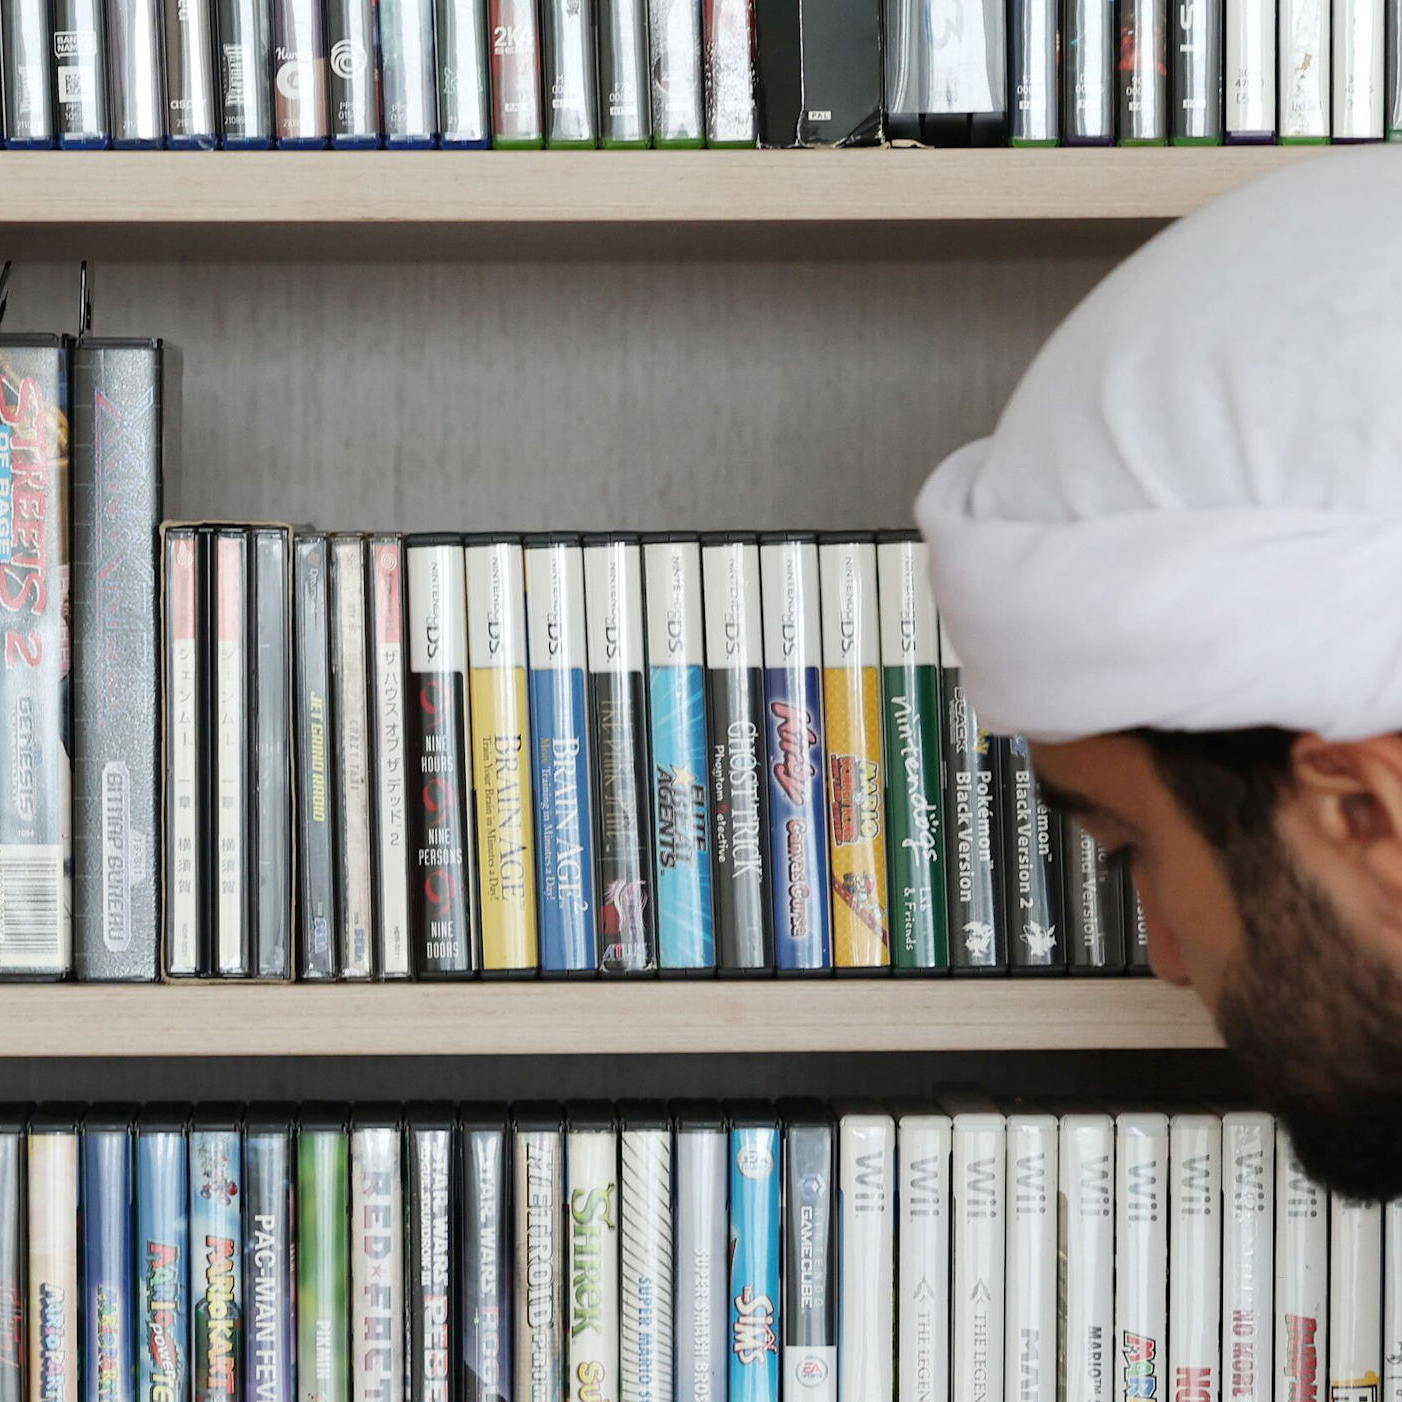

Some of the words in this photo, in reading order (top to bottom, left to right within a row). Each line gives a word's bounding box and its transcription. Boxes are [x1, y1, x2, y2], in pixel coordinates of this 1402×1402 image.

[5, 630, 41, 670] 2
[310, 691, 325, 721] JET
[311, 723, 324, 771] GRIND
[426, 736, 447, 752] NINE
[481, 737, 492, 760] Train
[727, 721, 758, 805] GHOST
[421, 756, 453, 772] HOURS
[482, 763, 493, 786] Your
[494, 733, 523, 830] BRAIN
[312, 773, 325, 822] RADIO
[484, 789, 494, 812] Brain
[955, 771, 973, 824] Black
[429, 828, 450, 844] NINE
[485, 814, 495, 825] in
[390, 834, 399, 846] 2
[419, 849, 462, 866] PERSONS
[485, 828, 496, 866] Minutes
[730, 807, 761, 880] TRICK
[787, 819, 807, 880] Canvas
[500, 836, 527, 900] AGE
[956, 827, 975, 902] Version
[486, 878, 499, 901] Day!
[790, 882, 808, 936] Curse
[431, 921, 453, 938] NINE
[427, 942, 459, 959] DOORS
[255, 1214, 276, 1343] PAC-MAN
[638, 1277, 653, 1326] SUPER
[973, 1312, 987, 1347] THE
[315, 1320, 331, 1379] PIKMIN
[638, 1332, 653, 1386] MARIO
